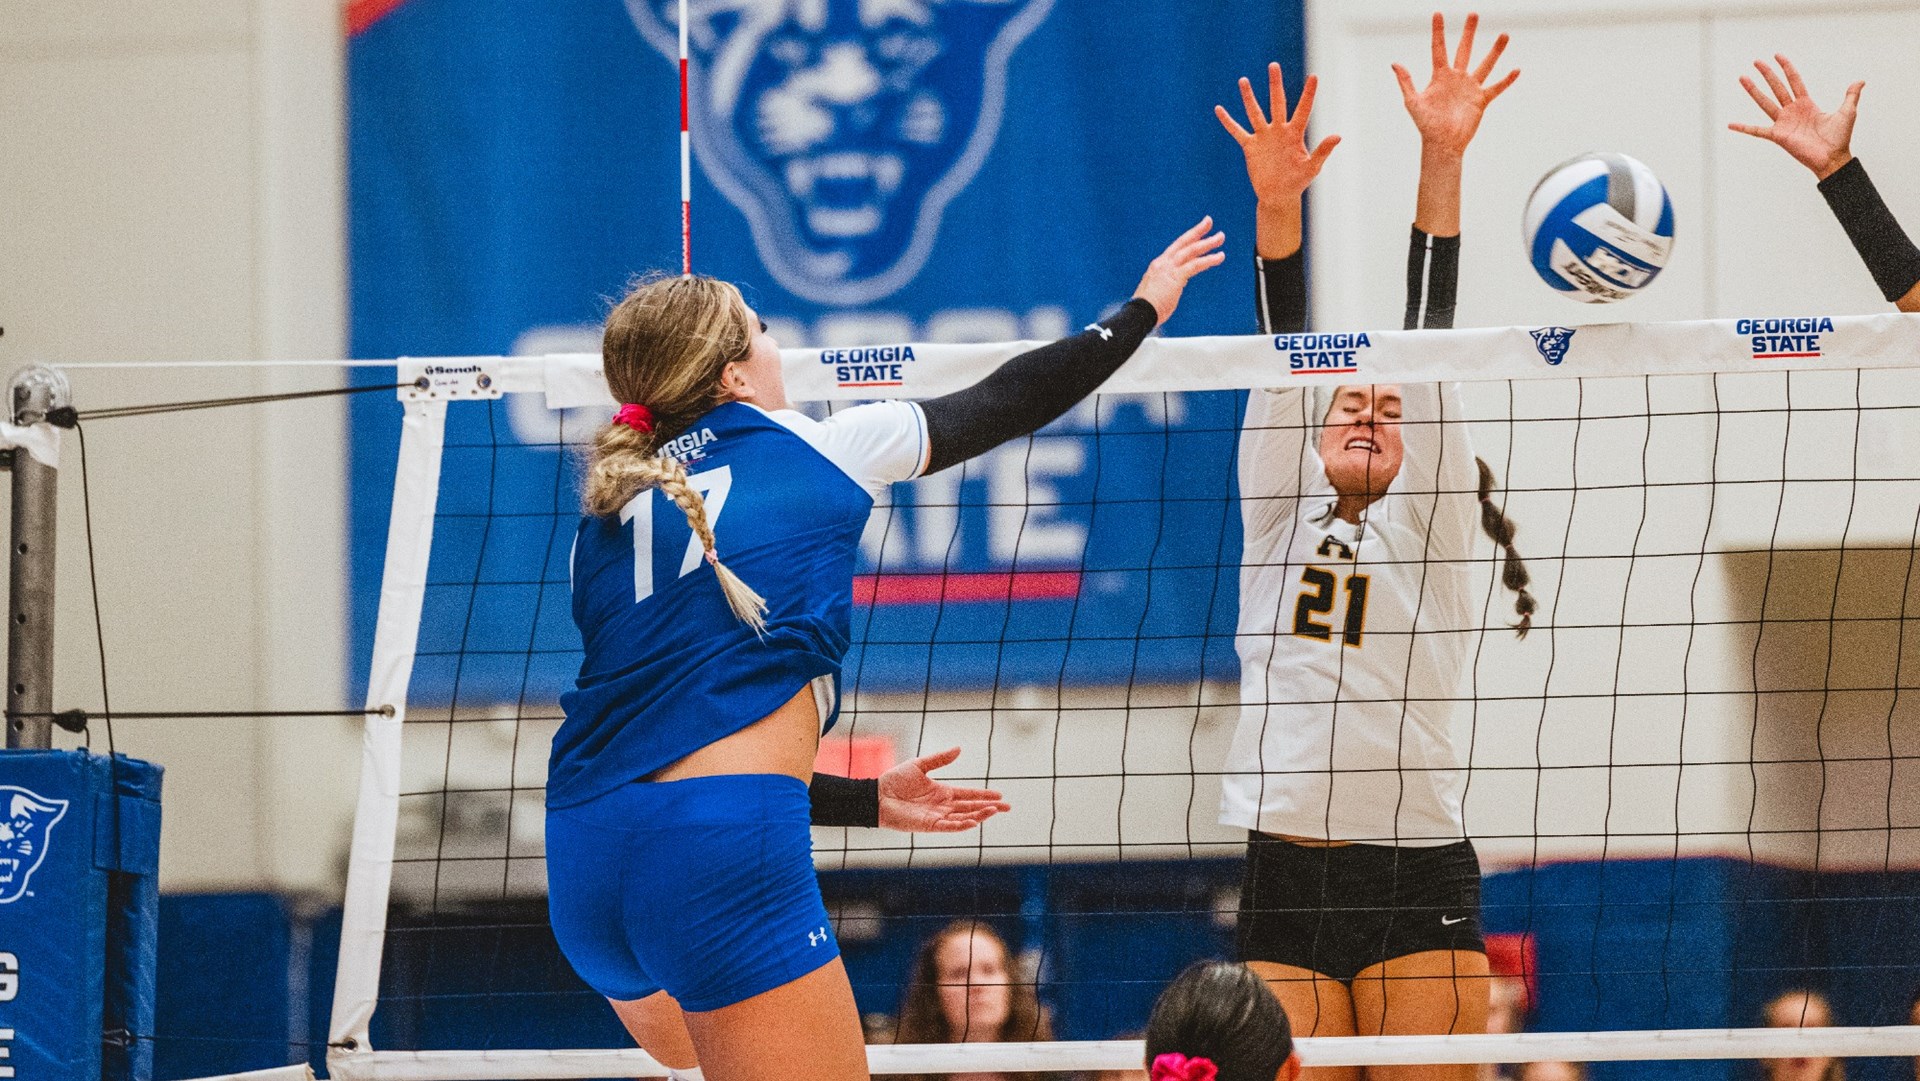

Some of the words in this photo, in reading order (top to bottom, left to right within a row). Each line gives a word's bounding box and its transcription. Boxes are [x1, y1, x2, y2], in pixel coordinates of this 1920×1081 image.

[1736, 317, 1834, 335] GEORGIA
[1274, 332, 1371, 351] GEORGIA
[1752, 334, 1820, 353] STATE
[820, 346, 916, 364] GEORGIA
[1289, 350, 1357, 369] STATE
[434, 365, 482, 374] Senoh
[836, 364, 903, 382] STATE
[656, 427, 719, 459] RGIA
[619, 464, 733, 604] 17
[1292, 563, 1371, 649] 21
